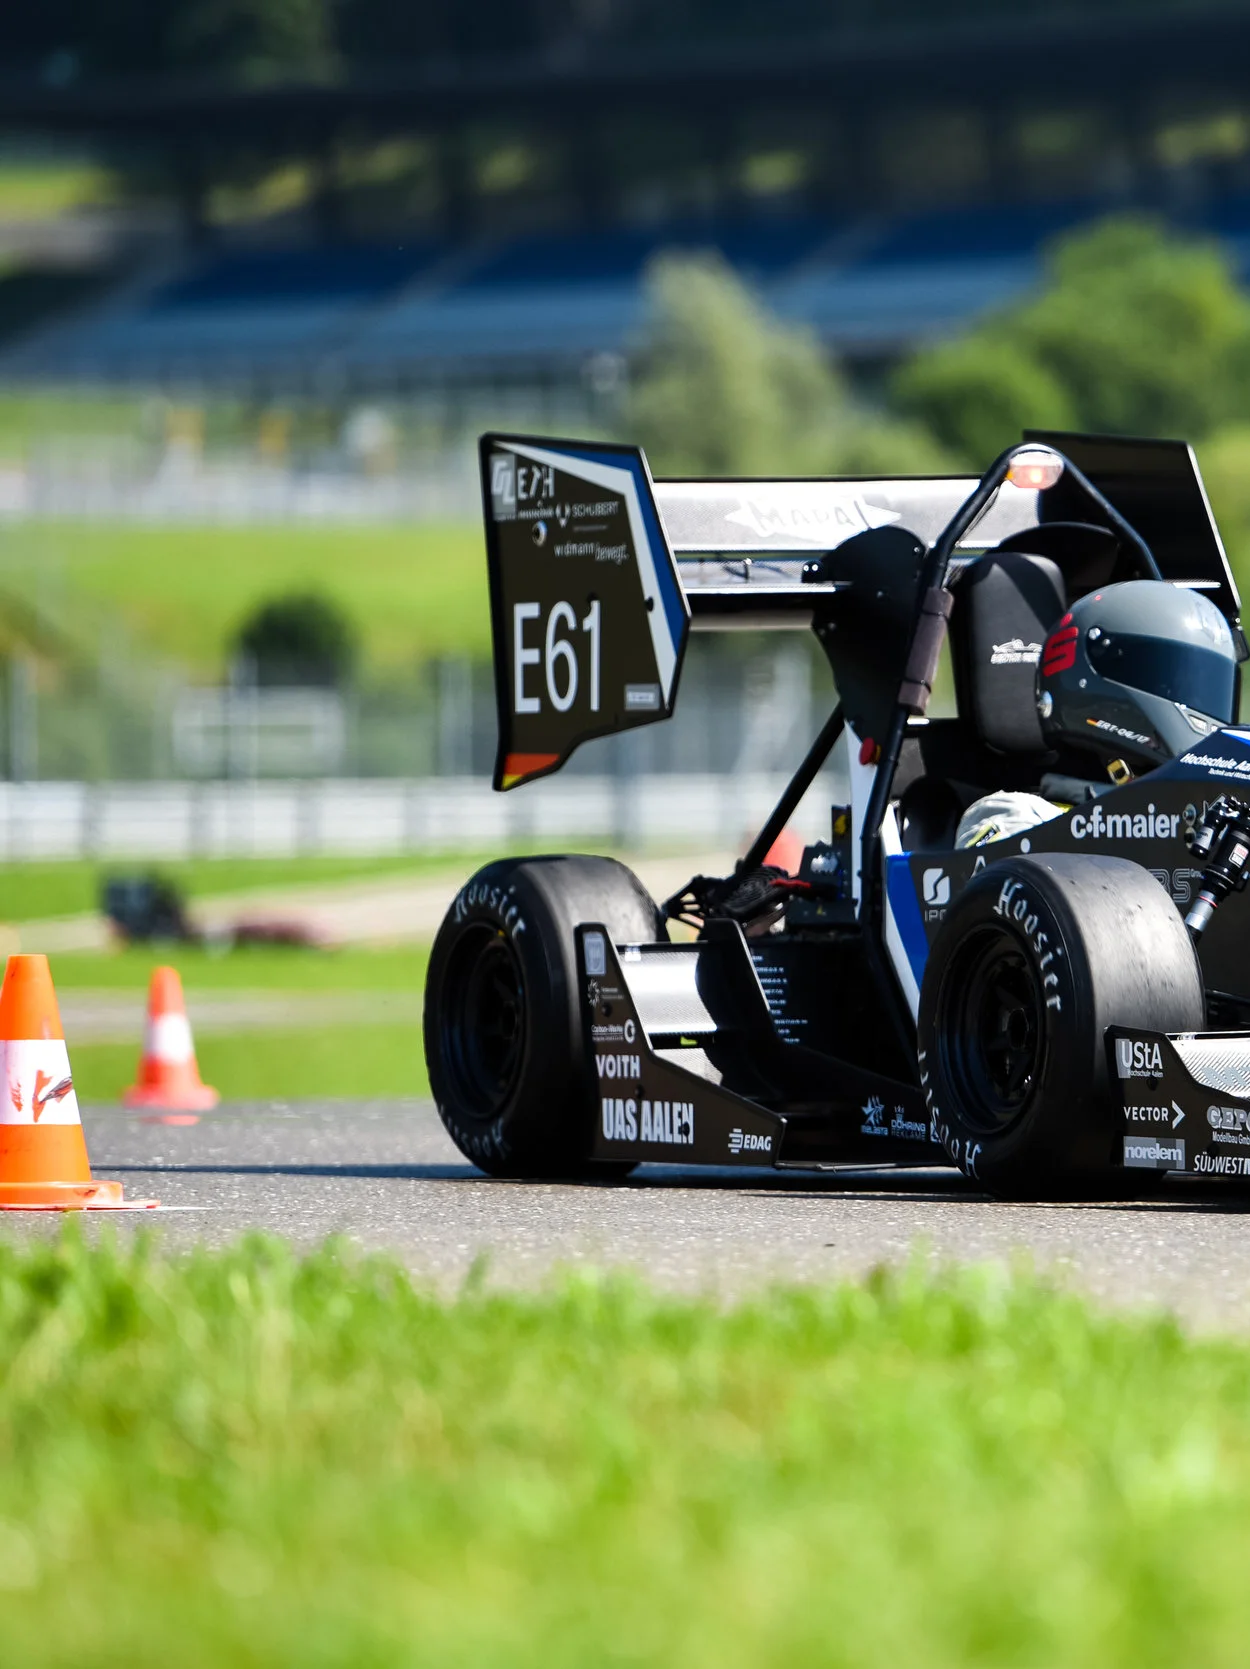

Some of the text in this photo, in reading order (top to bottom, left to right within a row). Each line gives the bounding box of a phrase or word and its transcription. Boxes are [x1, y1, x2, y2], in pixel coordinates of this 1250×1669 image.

[514, 600, 600, 714] E61
[1180, 752, 1237, 770] Hochschule
[993, 876, 1062, 1012] Hoosier
[1121, 1040, 1163, 1069] UStA
[595, 1054, 641, 1079] VOITH
[602, 1098, 694, 1145] UAS AALEN
[1124, 1106, 1169, 1122] VECTOR
[744, 1134, 771, 1151] EDAG
[1212, 1131, 1238, 1145] Modellbau
[1125, 1142, 1182, 1161] norelem
